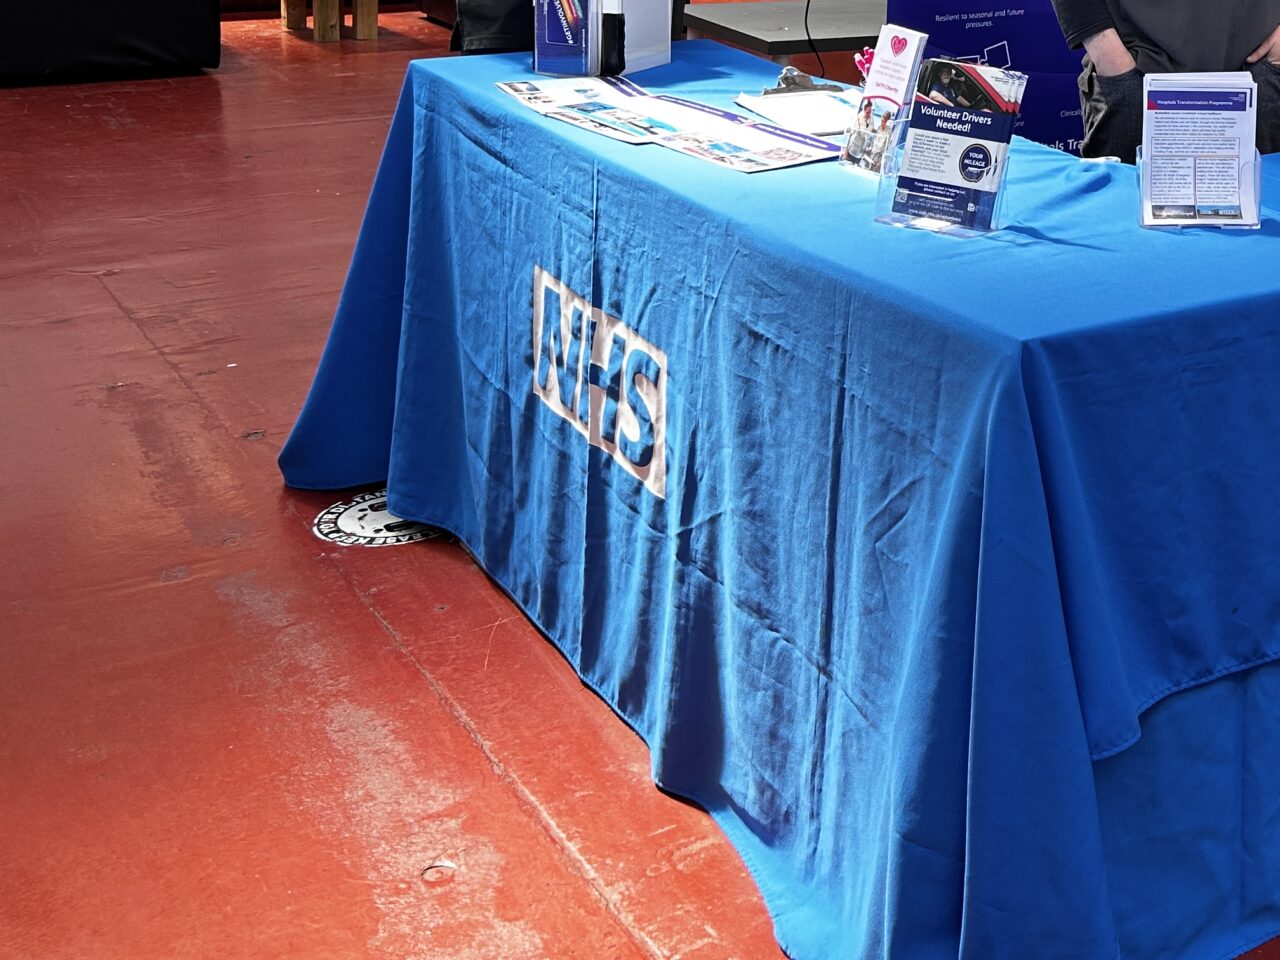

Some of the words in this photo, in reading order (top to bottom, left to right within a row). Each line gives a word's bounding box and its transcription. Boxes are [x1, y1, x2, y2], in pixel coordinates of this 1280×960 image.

[936, 13, 960, 22] Resilient
[969, 11, 993, 19] seasonal
[994, 9, 1006, 17] and
[1007, 8, 1024, 16] future
[920, 105, 961, 120] Volunteer
[962, 109, 992, 125] Drivers
[936, 119, 971, 133] Needed!
[963, 159, 986, 167] MILEAGE
[538, 280, 662, 470] NHS
